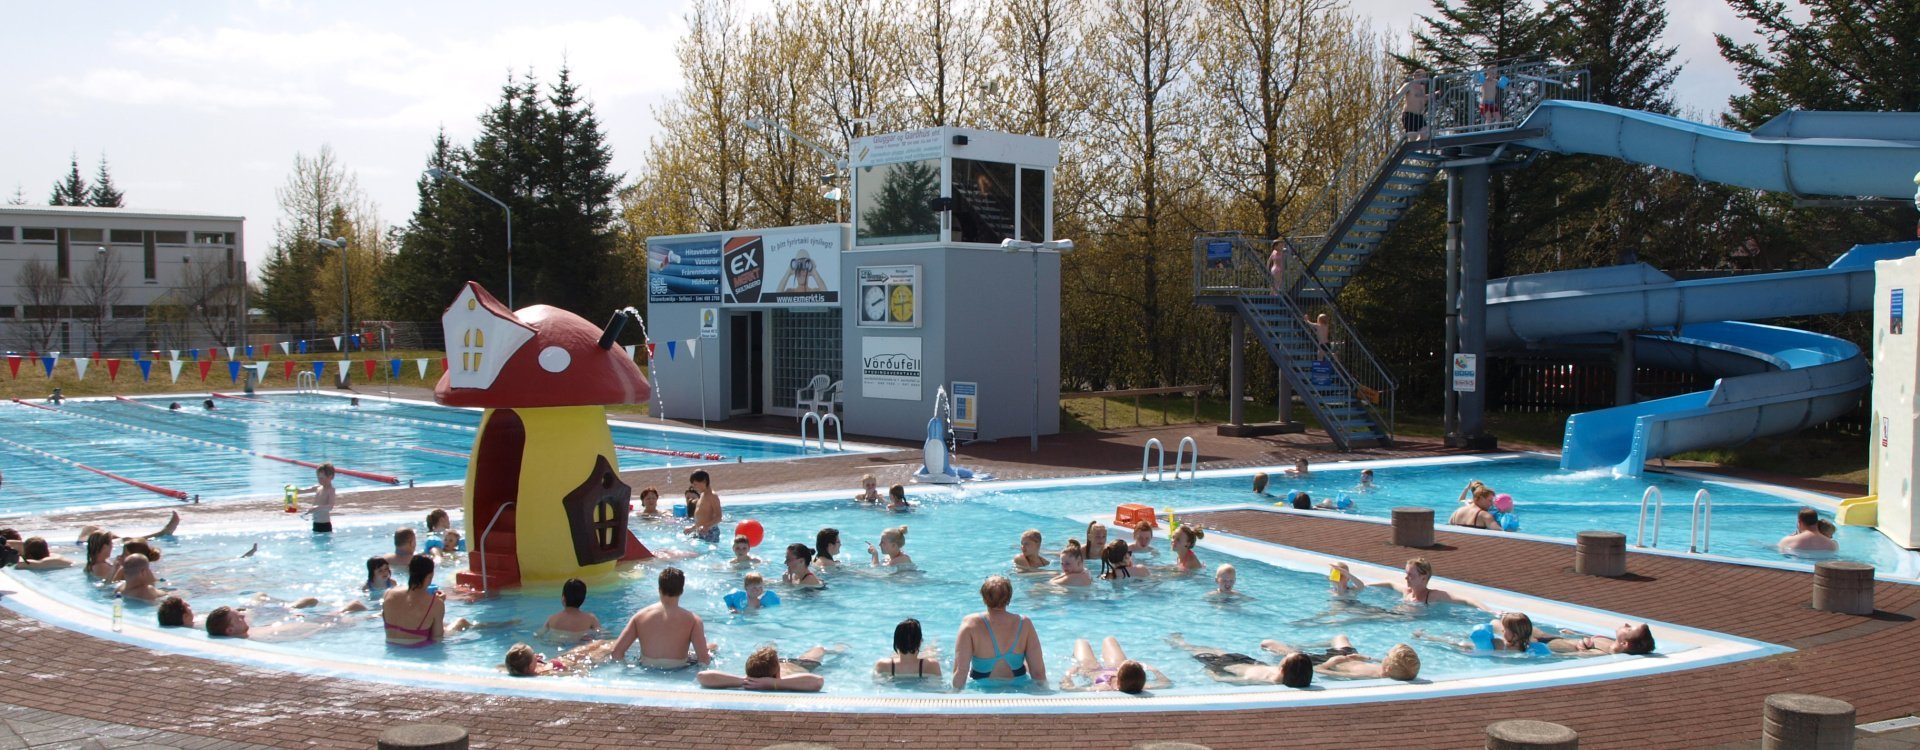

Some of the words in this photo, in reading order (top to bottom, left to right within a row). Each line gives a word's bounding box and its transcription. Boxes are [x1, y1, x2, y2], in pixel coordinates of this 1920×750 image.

[730, 248, 758, 275] EX
[776, 294, 825, 303] www.exmerkt.is
[863, 357, 920, 370] Vörðufell
